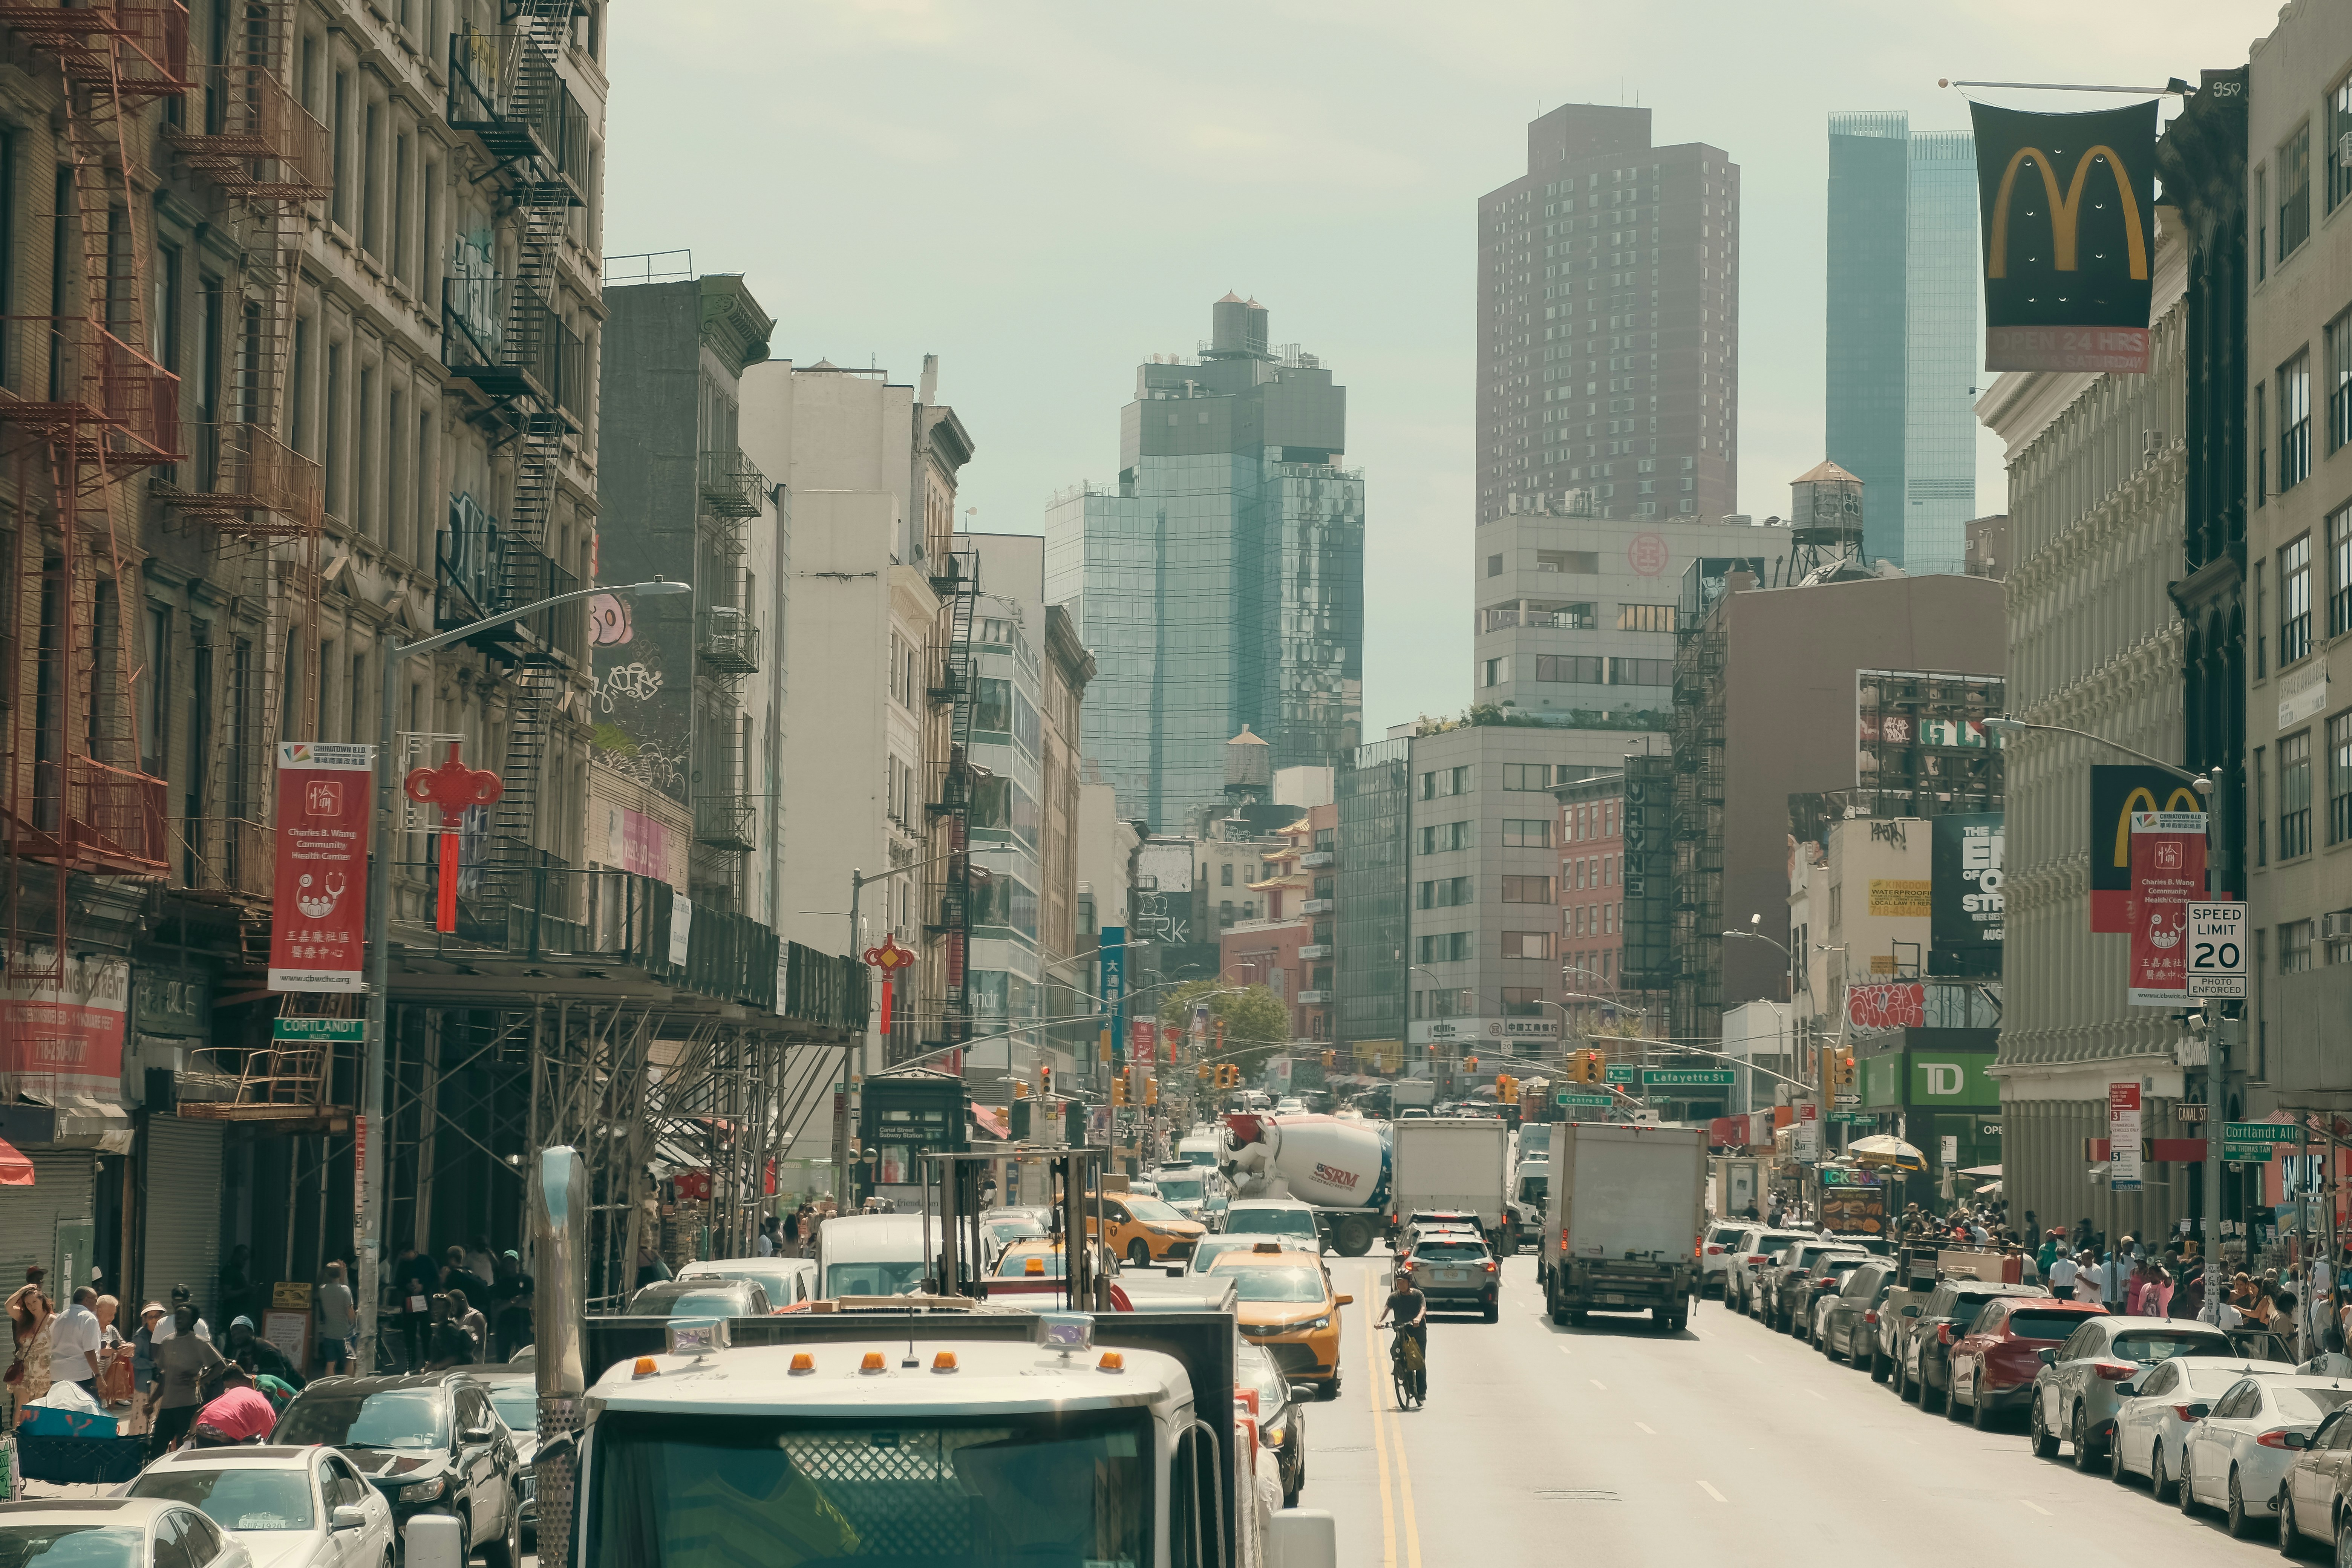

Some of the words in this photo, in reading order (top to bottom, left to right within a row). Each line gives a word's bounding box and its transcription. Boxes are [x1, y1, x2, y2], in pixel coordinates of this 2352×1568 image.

[1997, 332, 2055, 350] OPEN
[2063, 332, 2092, 350] 24
[2097, 332, 2145, 352] HRS
[1998, 355, 2047, 367] RIDAY
[2065, 355, 2145, 369] SATURDAY
[288, 828, 320, 836] Charles
[331, 830, 357, 839] Wang
[1963, 827, 1989, 836] THE
[296, 840, 347, 850] Community
[322, 852, 352, 861] Center
[1963, 870, 1980, 880] OF
[1963, 894, 2005, 912] STR
[2193, 908, 2242, 920] SPEED
[1983, 929, 2005, 940] AUG
[2197, 924, 2236, 935] LIMIT
[2194, 942, 2240, 969] 20
[2141, 957, 2186, 968] 王嘉廉社
[31, 963, 81, 993] BUILING
[101, 972, 124, 1001] RENT
[101, 1015, 113, 1031] FEET
[283, 1020, 358, 1032] CORTLANDT
[2178, 1035, 2209, 1067] McDonal
[1653, 1073, 1709, 1083] Lafayette
[1918, 1063, 1964, 1095] TD
[2113, 1112, 2118, 1120] 3
[2178, 1107, 2197, 1121] CANAL
[2199, 1107, 2207, 1121] ST
[1983, 1125, 2003, 1135] OPE
[2226, 1126, 2275, 1138] Cortlandt
[2280, 1127, 2299, 1139] Alle
[2113, 1152, 2118, 1161] 5
[1324, 1166, 1360, 1188] SRM
[1308, 1175, 1354, 1192] CONCRETE
